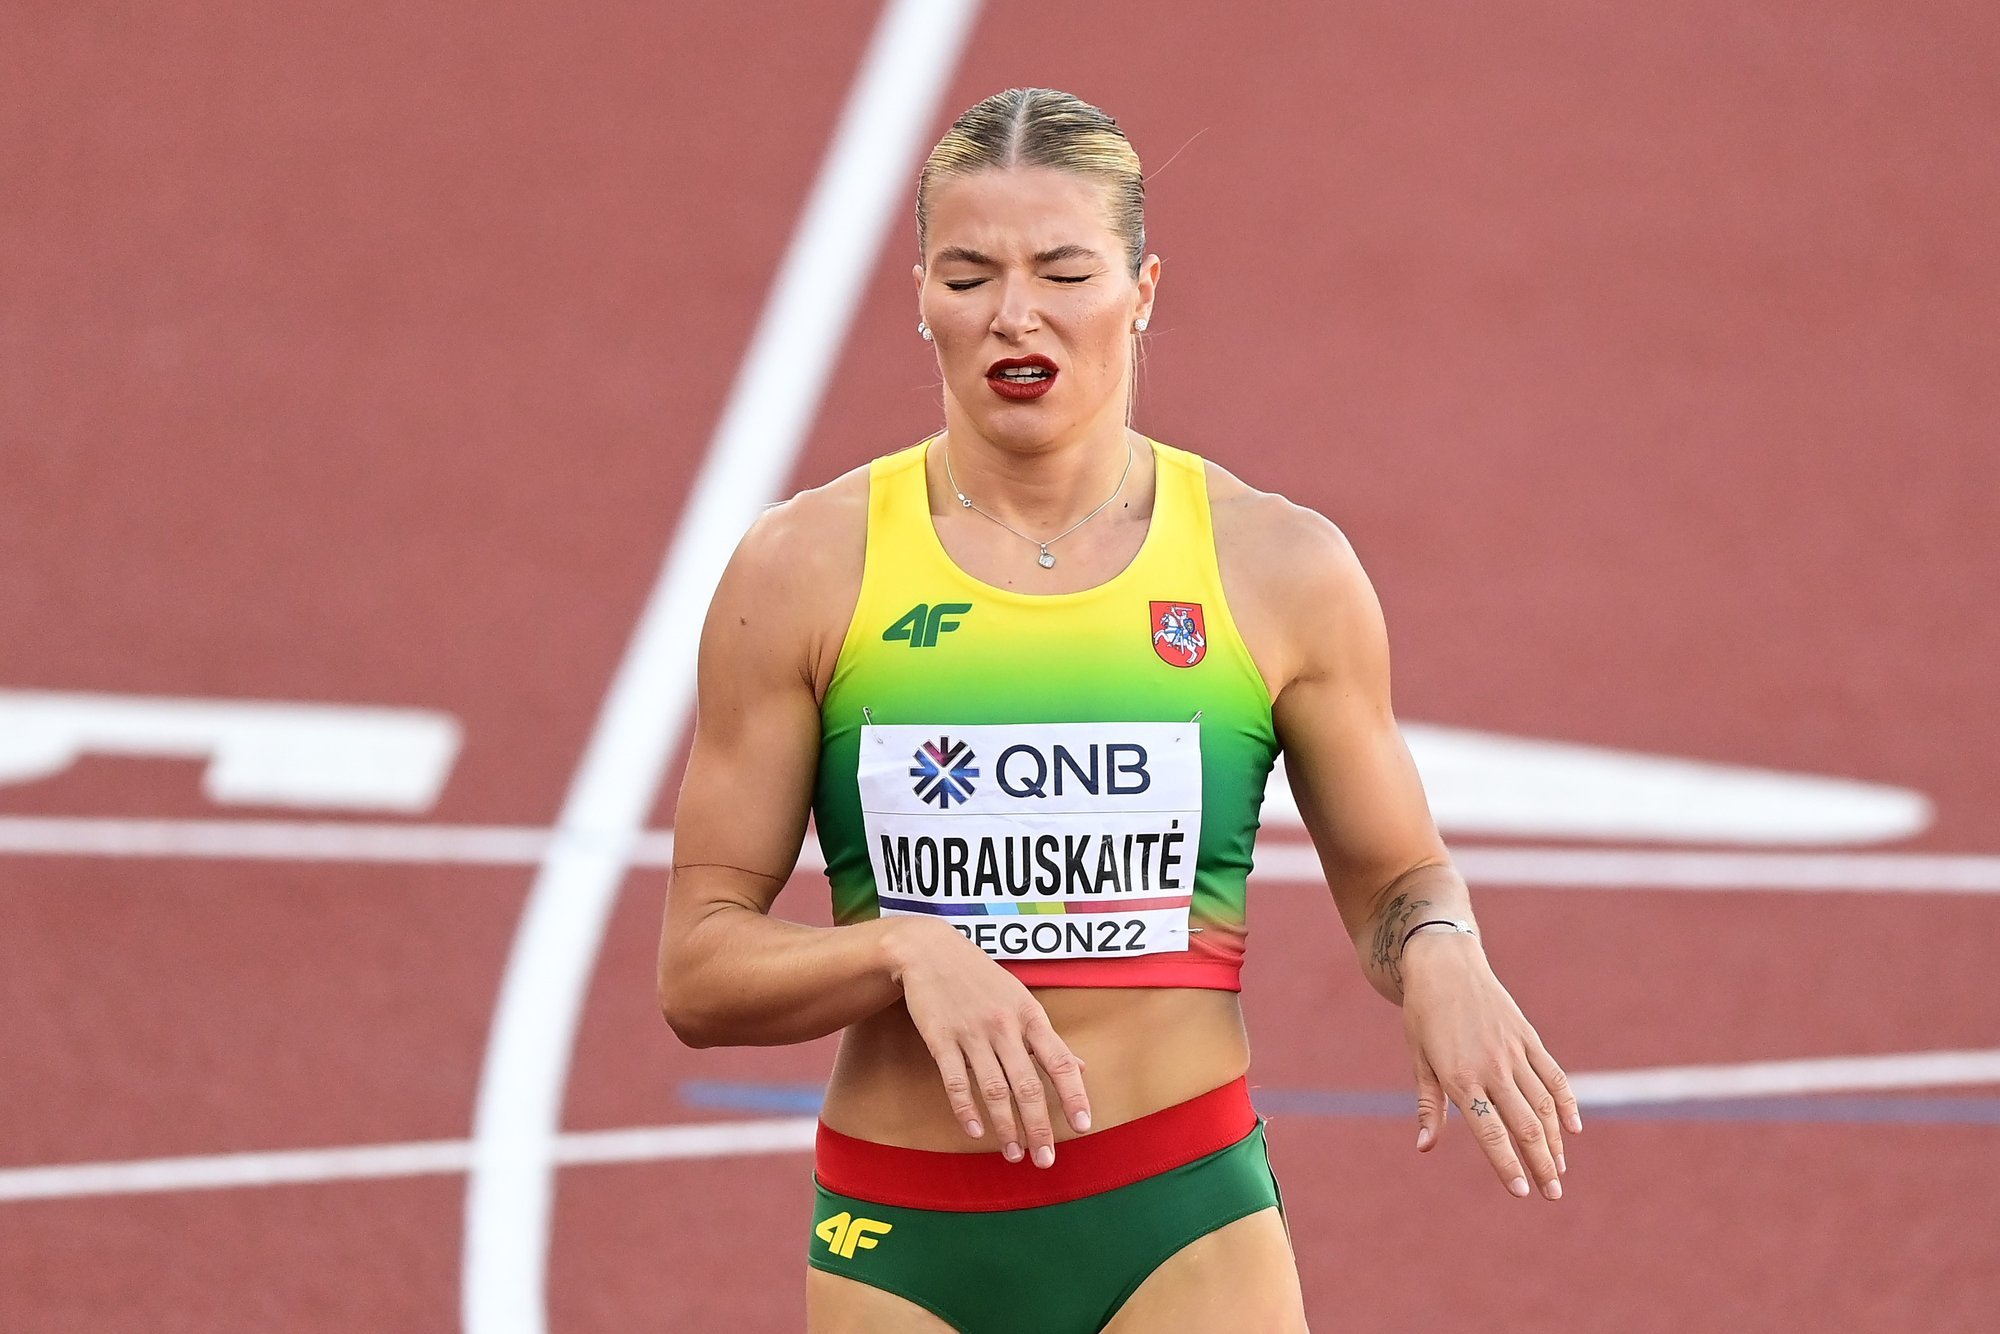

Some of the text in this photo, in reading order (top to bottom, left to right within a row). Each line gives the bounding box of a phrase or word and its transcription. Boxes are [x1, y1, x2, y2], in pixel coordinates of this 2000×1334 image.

[882, 603, 973, 648] 4F
[995, 743, 1151, 799] QNB
[880, 819, 1185, 897] MORAUSKAITĖ
[951, 919, 1147, 954] EGON22
[816, 1211, 893, 1260] 4F
